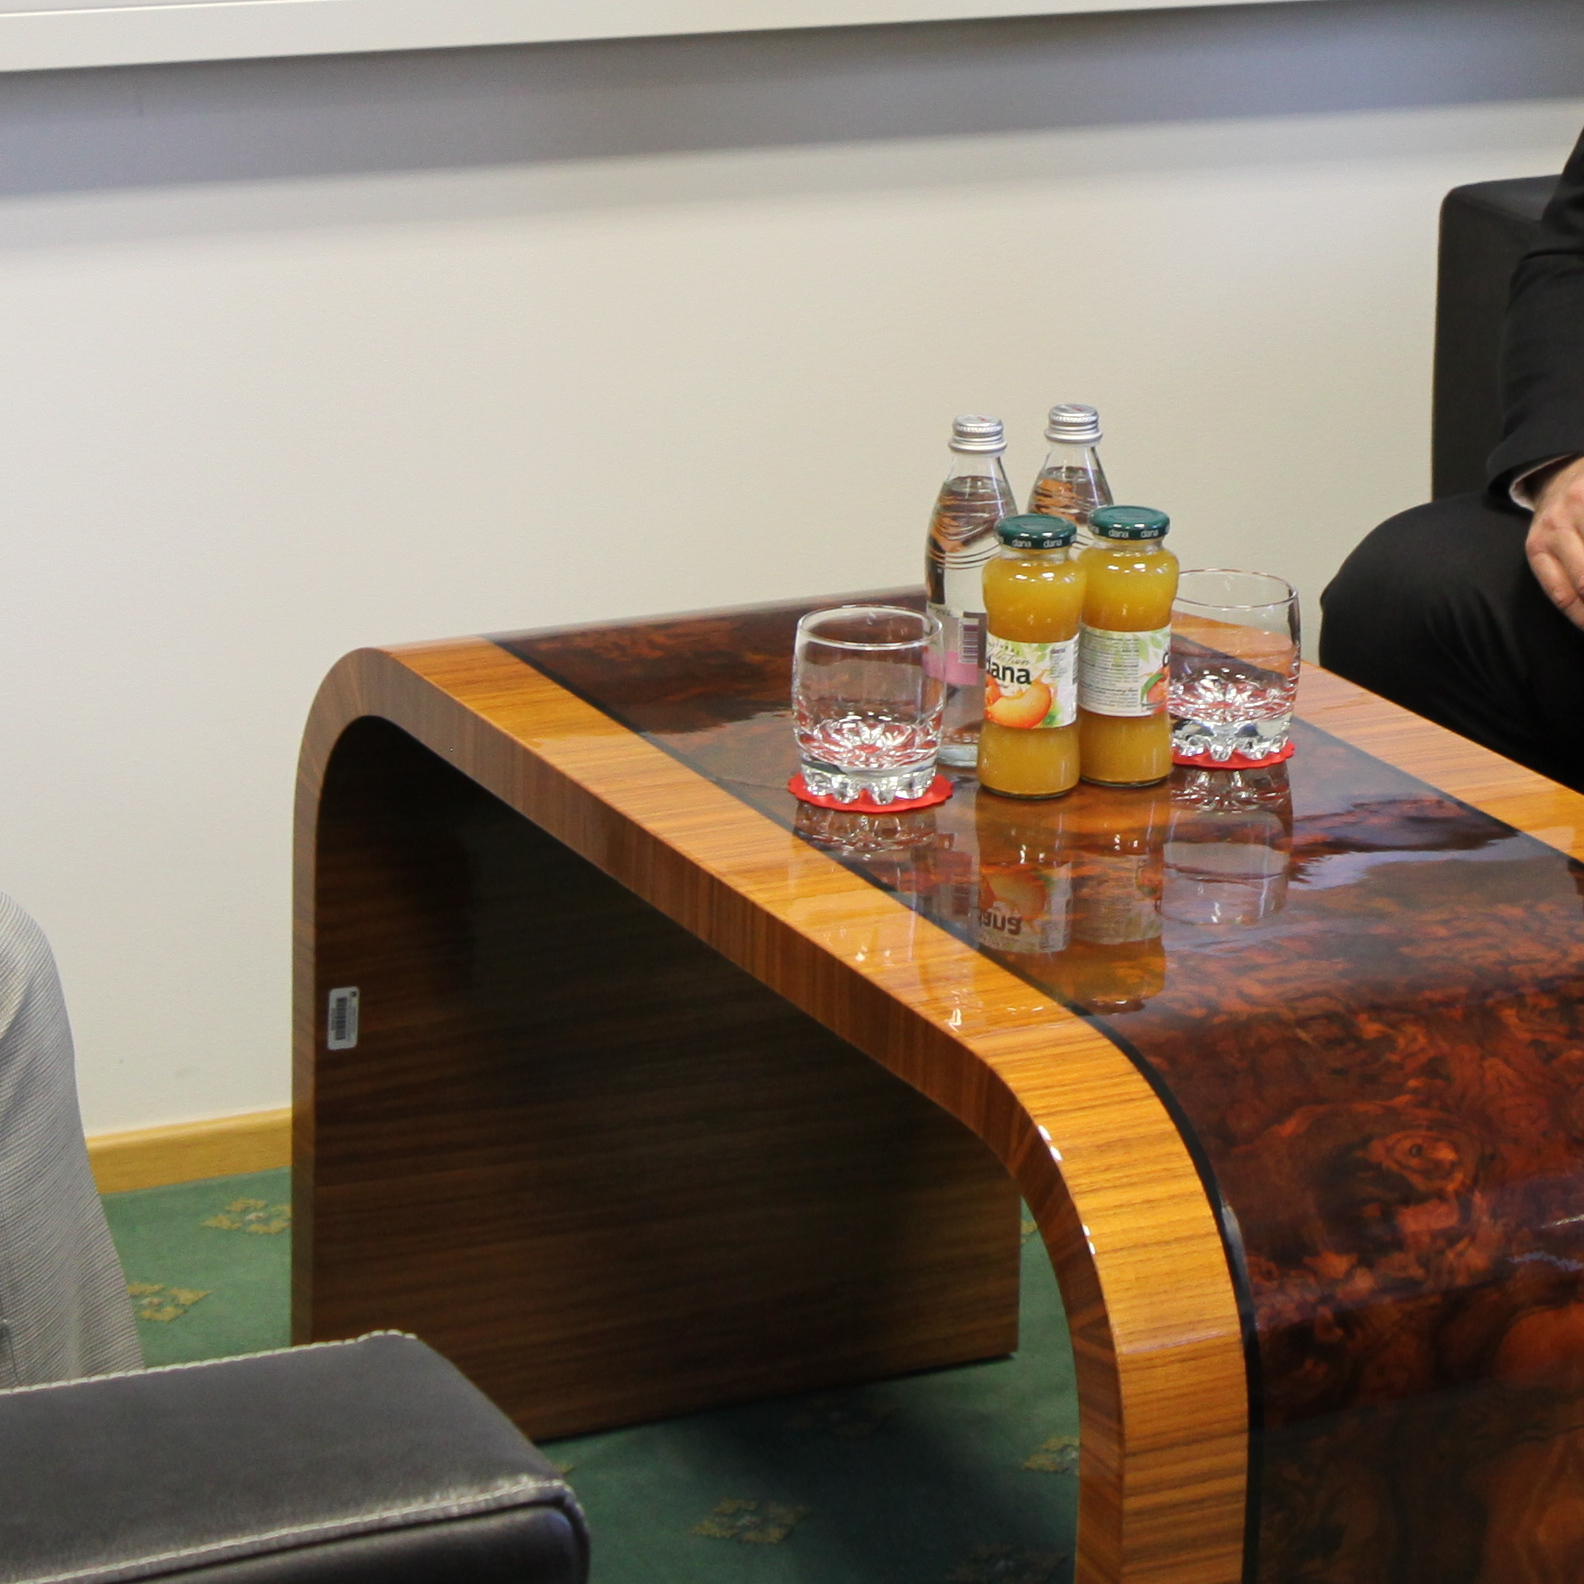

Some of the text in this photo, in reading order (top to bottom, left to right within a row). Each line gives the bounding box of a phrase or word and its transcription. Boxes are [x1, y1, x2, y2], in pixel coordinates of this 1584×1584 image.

[1108, 529, 1129, 538] dana
[1012, 539, 1032, 548] dana
[1043, 538, 1063, 548] dana
